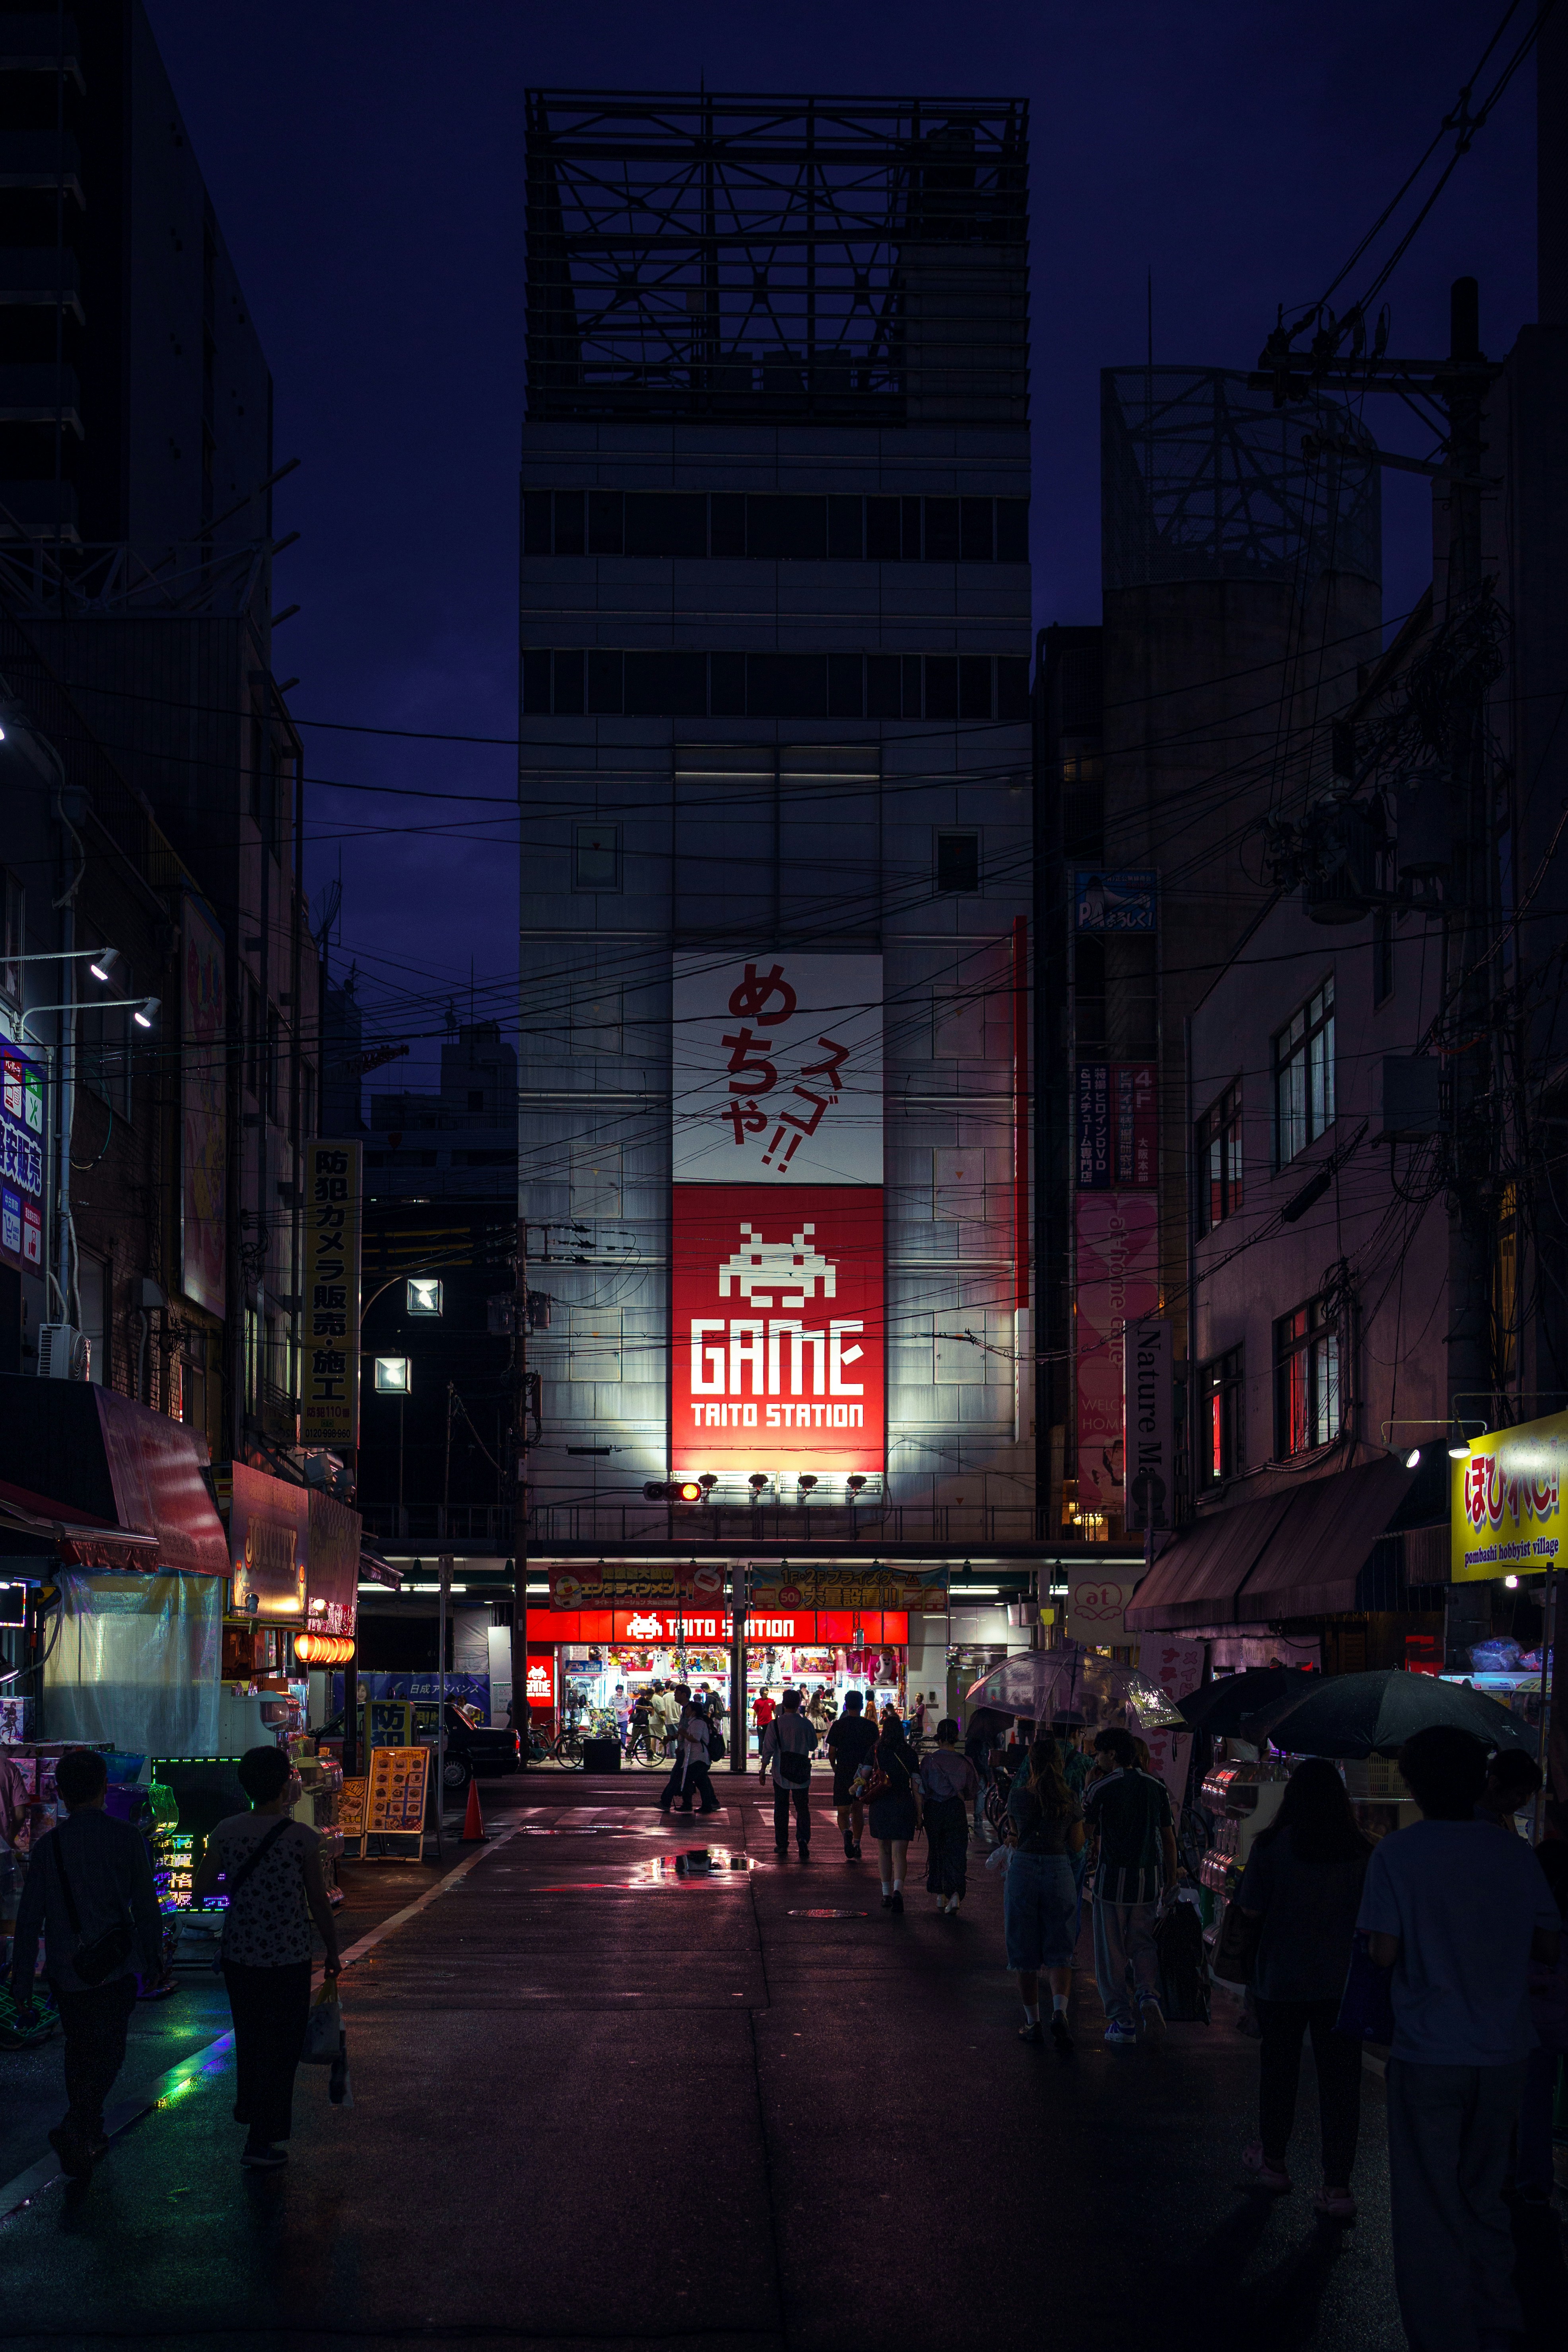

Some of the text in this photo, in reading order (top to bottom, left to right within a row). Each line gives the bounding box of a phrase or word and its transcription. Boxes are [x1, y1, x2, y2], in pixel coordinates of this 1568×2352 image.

[721, 963, 797, 1145] めちゃ
[1135, 1069, 1152, 1108] 4F
[1138, 1137, 1149, 1182] 大阪本部
[312, 1150, 349, 1401] 防犯カメラ販売・施工
[690, 1319, 864, 1395] GAME
[1137, 1330, 1161, 1433] Nature
[306, 1406, 350, 1418] 防犯110番
[690, 1403, 864, 1427] TAITO STATION
[1082, 1399, 1123, 1411] WELC
[1465, 1536, 1559, 1569] pombashi hobbyist village
[804, 1586, 899, 1608] 大量設置!!
[1086, 1588, 1109, 1605] at
[410, 1684, 479, 1694] 日成アドバンス
[370, 1704, 406, 1747] 防犯
